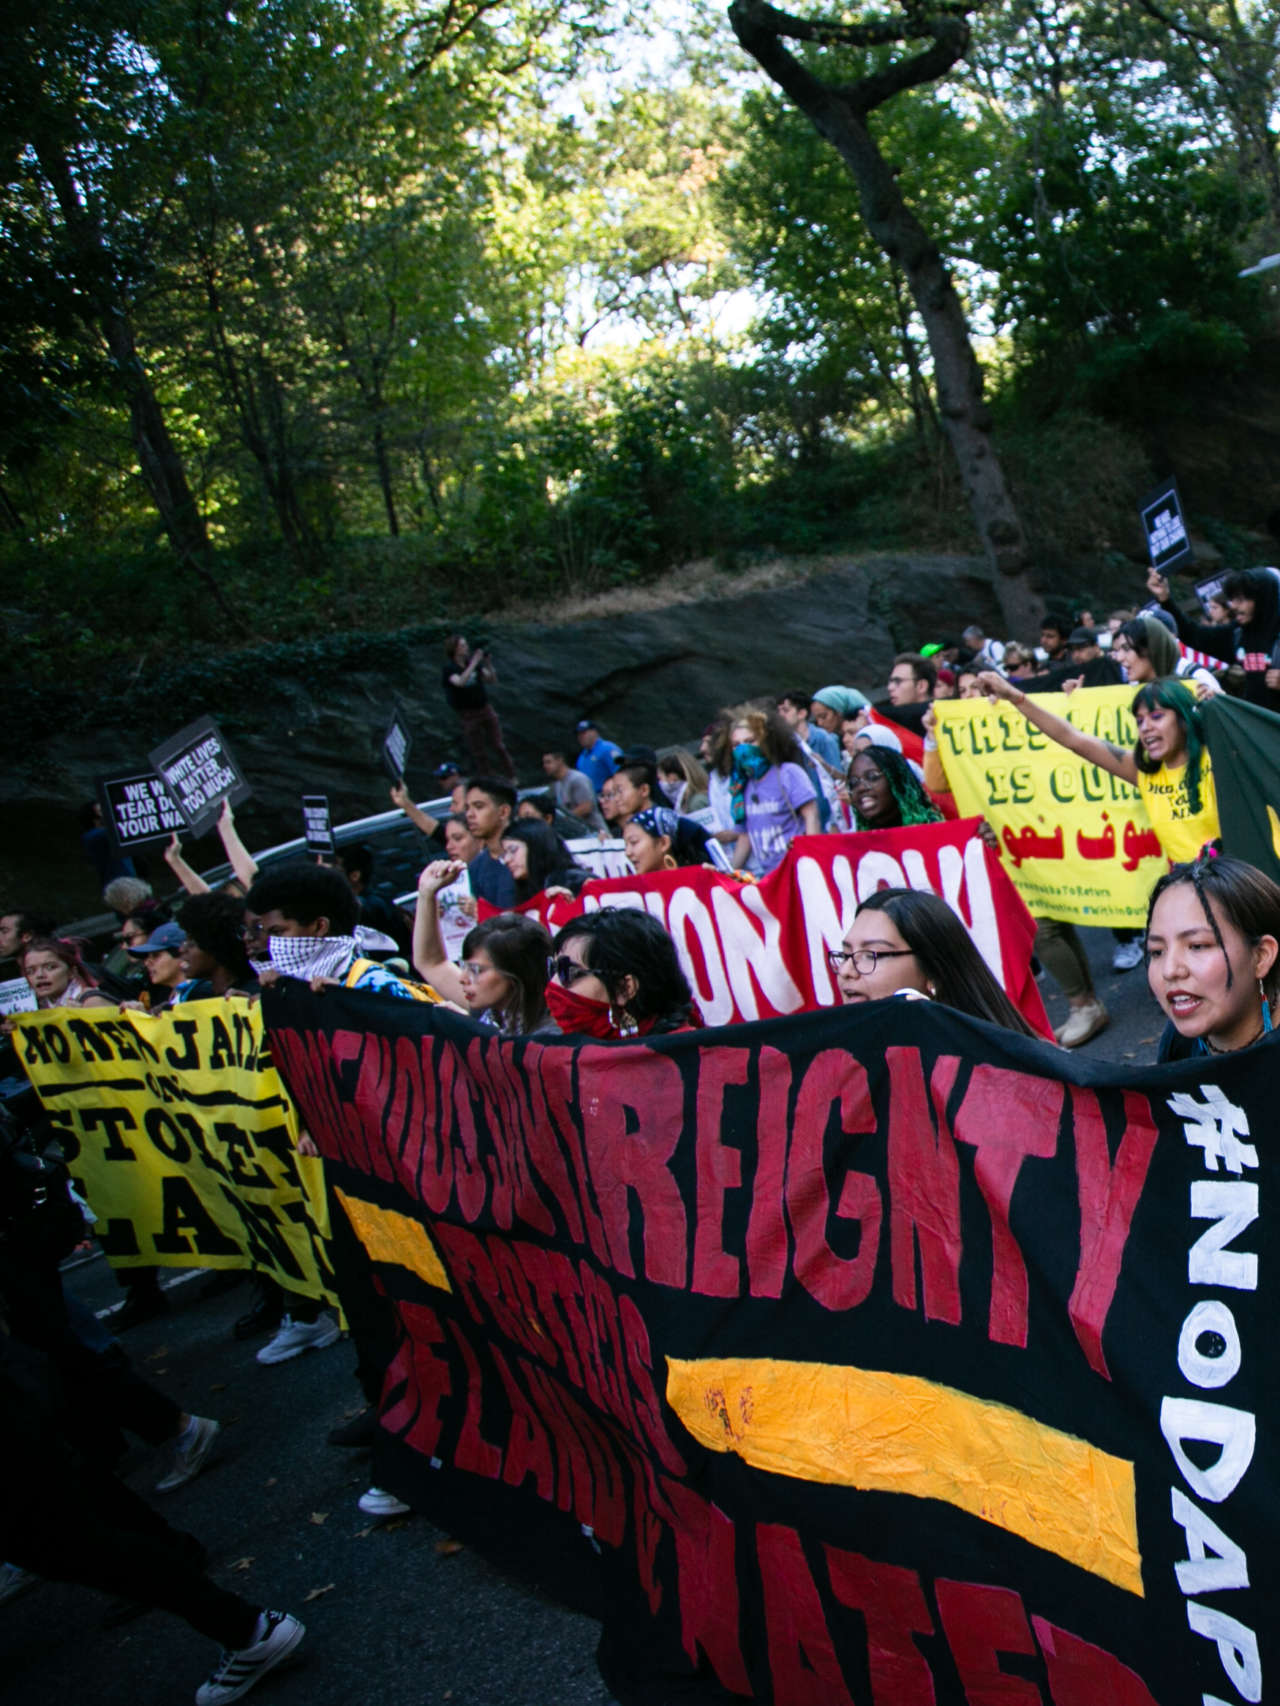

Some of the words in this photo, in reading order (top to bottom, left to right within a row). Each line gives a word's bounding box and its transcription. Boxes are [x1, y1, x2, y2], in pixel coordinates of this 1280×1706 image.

[190, 737, 221, 764] LIVES
[943, 710, 1047, 755] THIS
[124, 781, 150, 801] WE
[178, 758, 221, 796] MATTER
[182, 792, 206, 814] TOO
[202, 766, 235, 799] MUCH
[986, 766, 1035, 806] IS
[116, 796, 157, 820] TEAR
[117, 816, 161, 838] YOUR
[20, 1021, 71, 1065] NO
[1160, 1084, 1262, 1706] #NODAP
